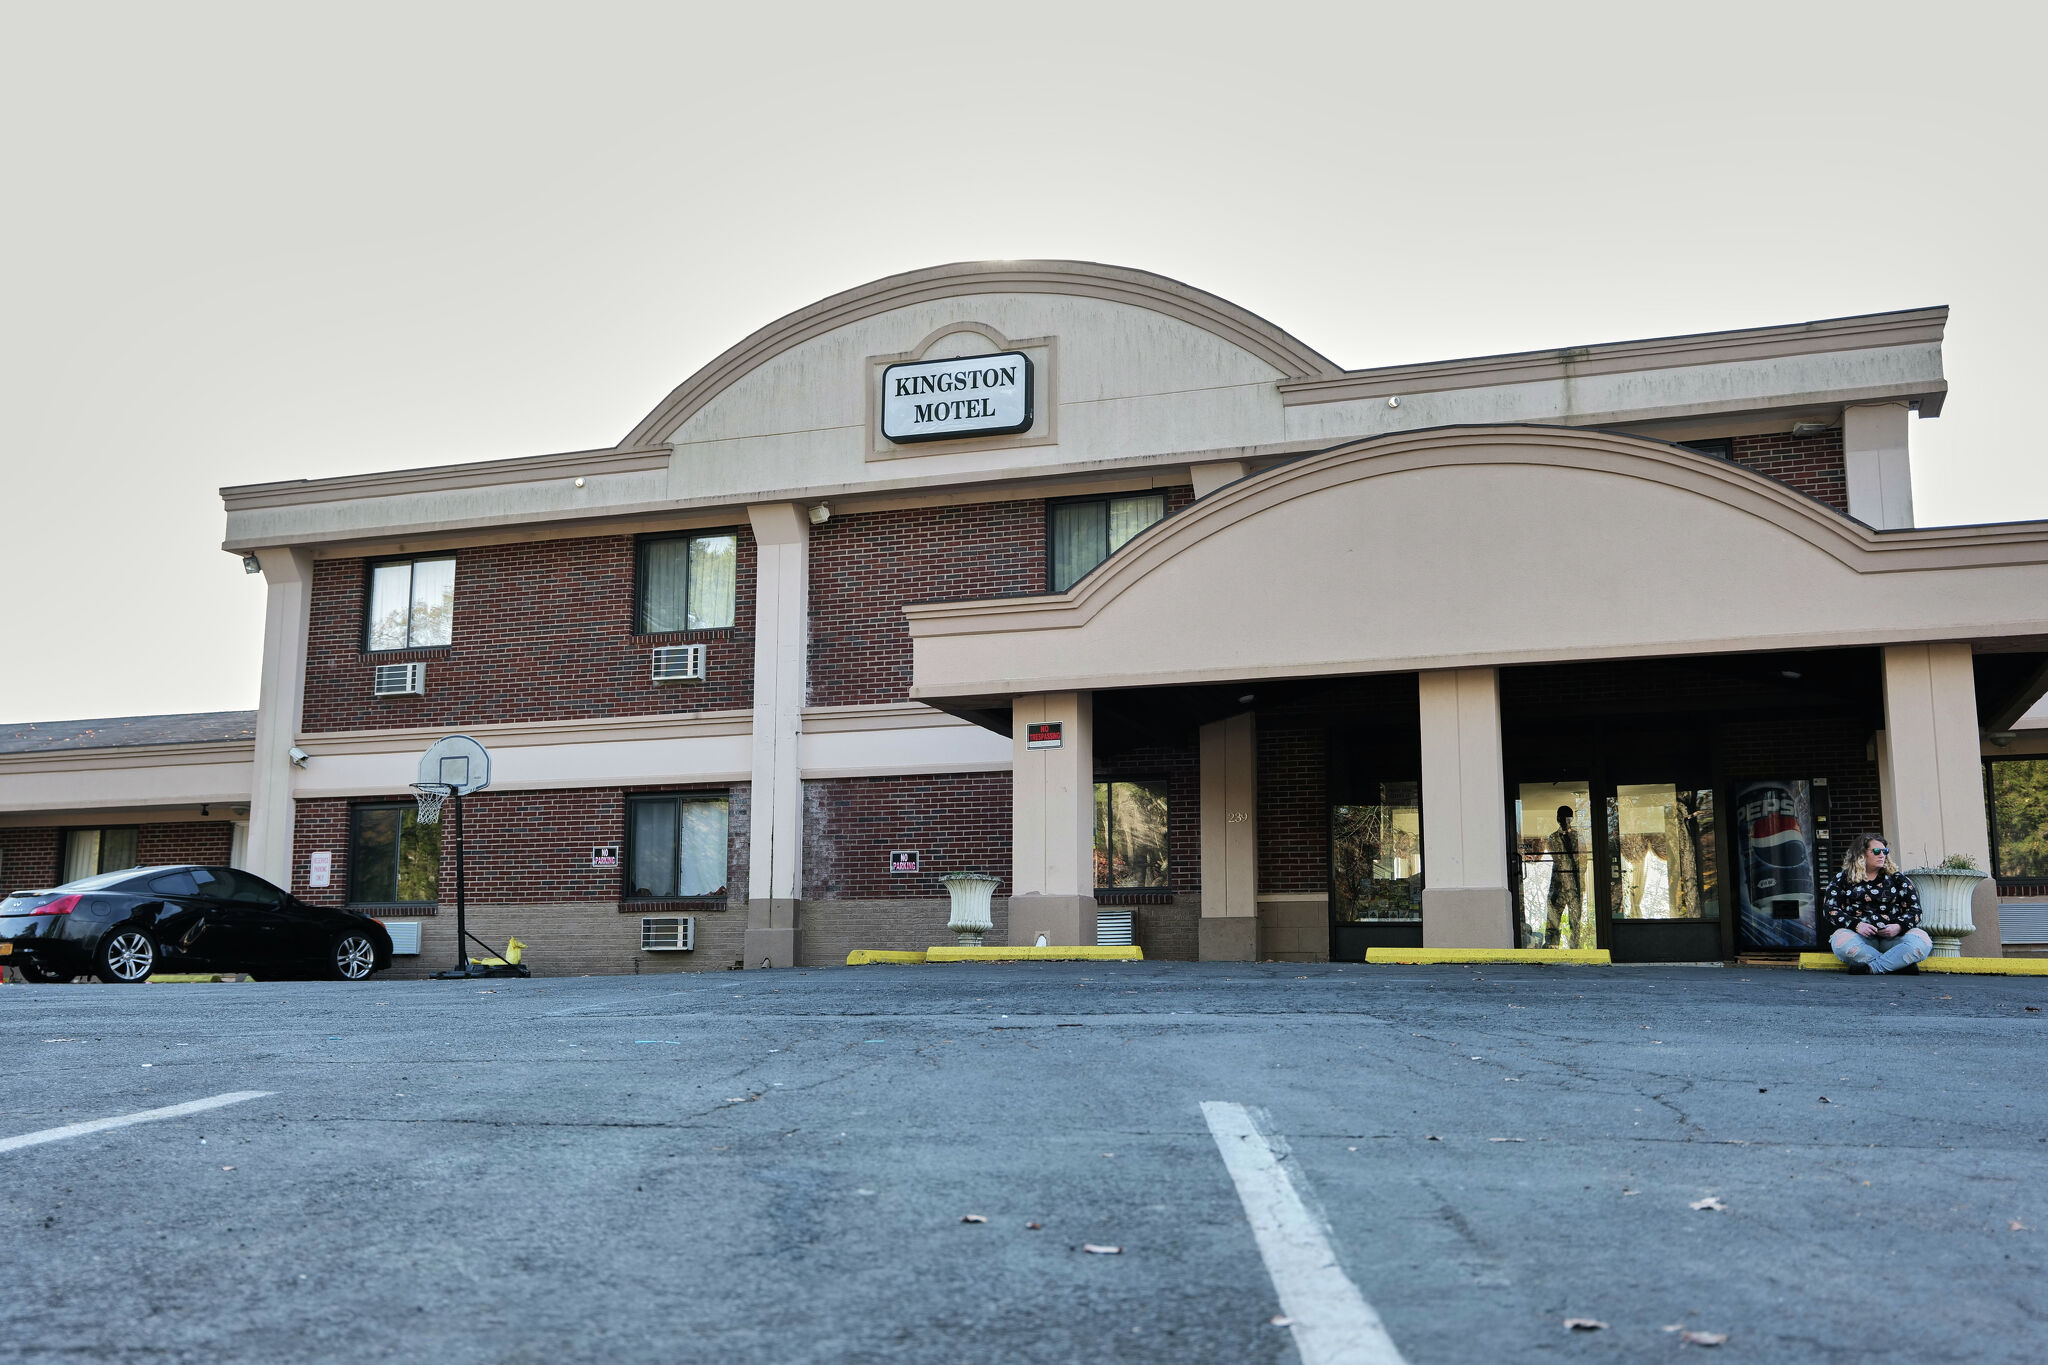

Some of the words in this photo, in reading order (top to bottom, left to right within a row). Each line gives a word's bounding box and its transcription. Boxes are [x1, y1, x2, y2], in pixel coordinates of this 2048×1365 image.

[895, 366, 1017, 397] KINGSTON
[913, 398, 996, 424] MOTEL
[1040, 725, 1049, 733] NO
[1228, 812, 1248, 823] 239
[601, 848, 609, 857] NO
[900, 853, 909, 862] NO
[893, 861, 916, 870] PARKING
